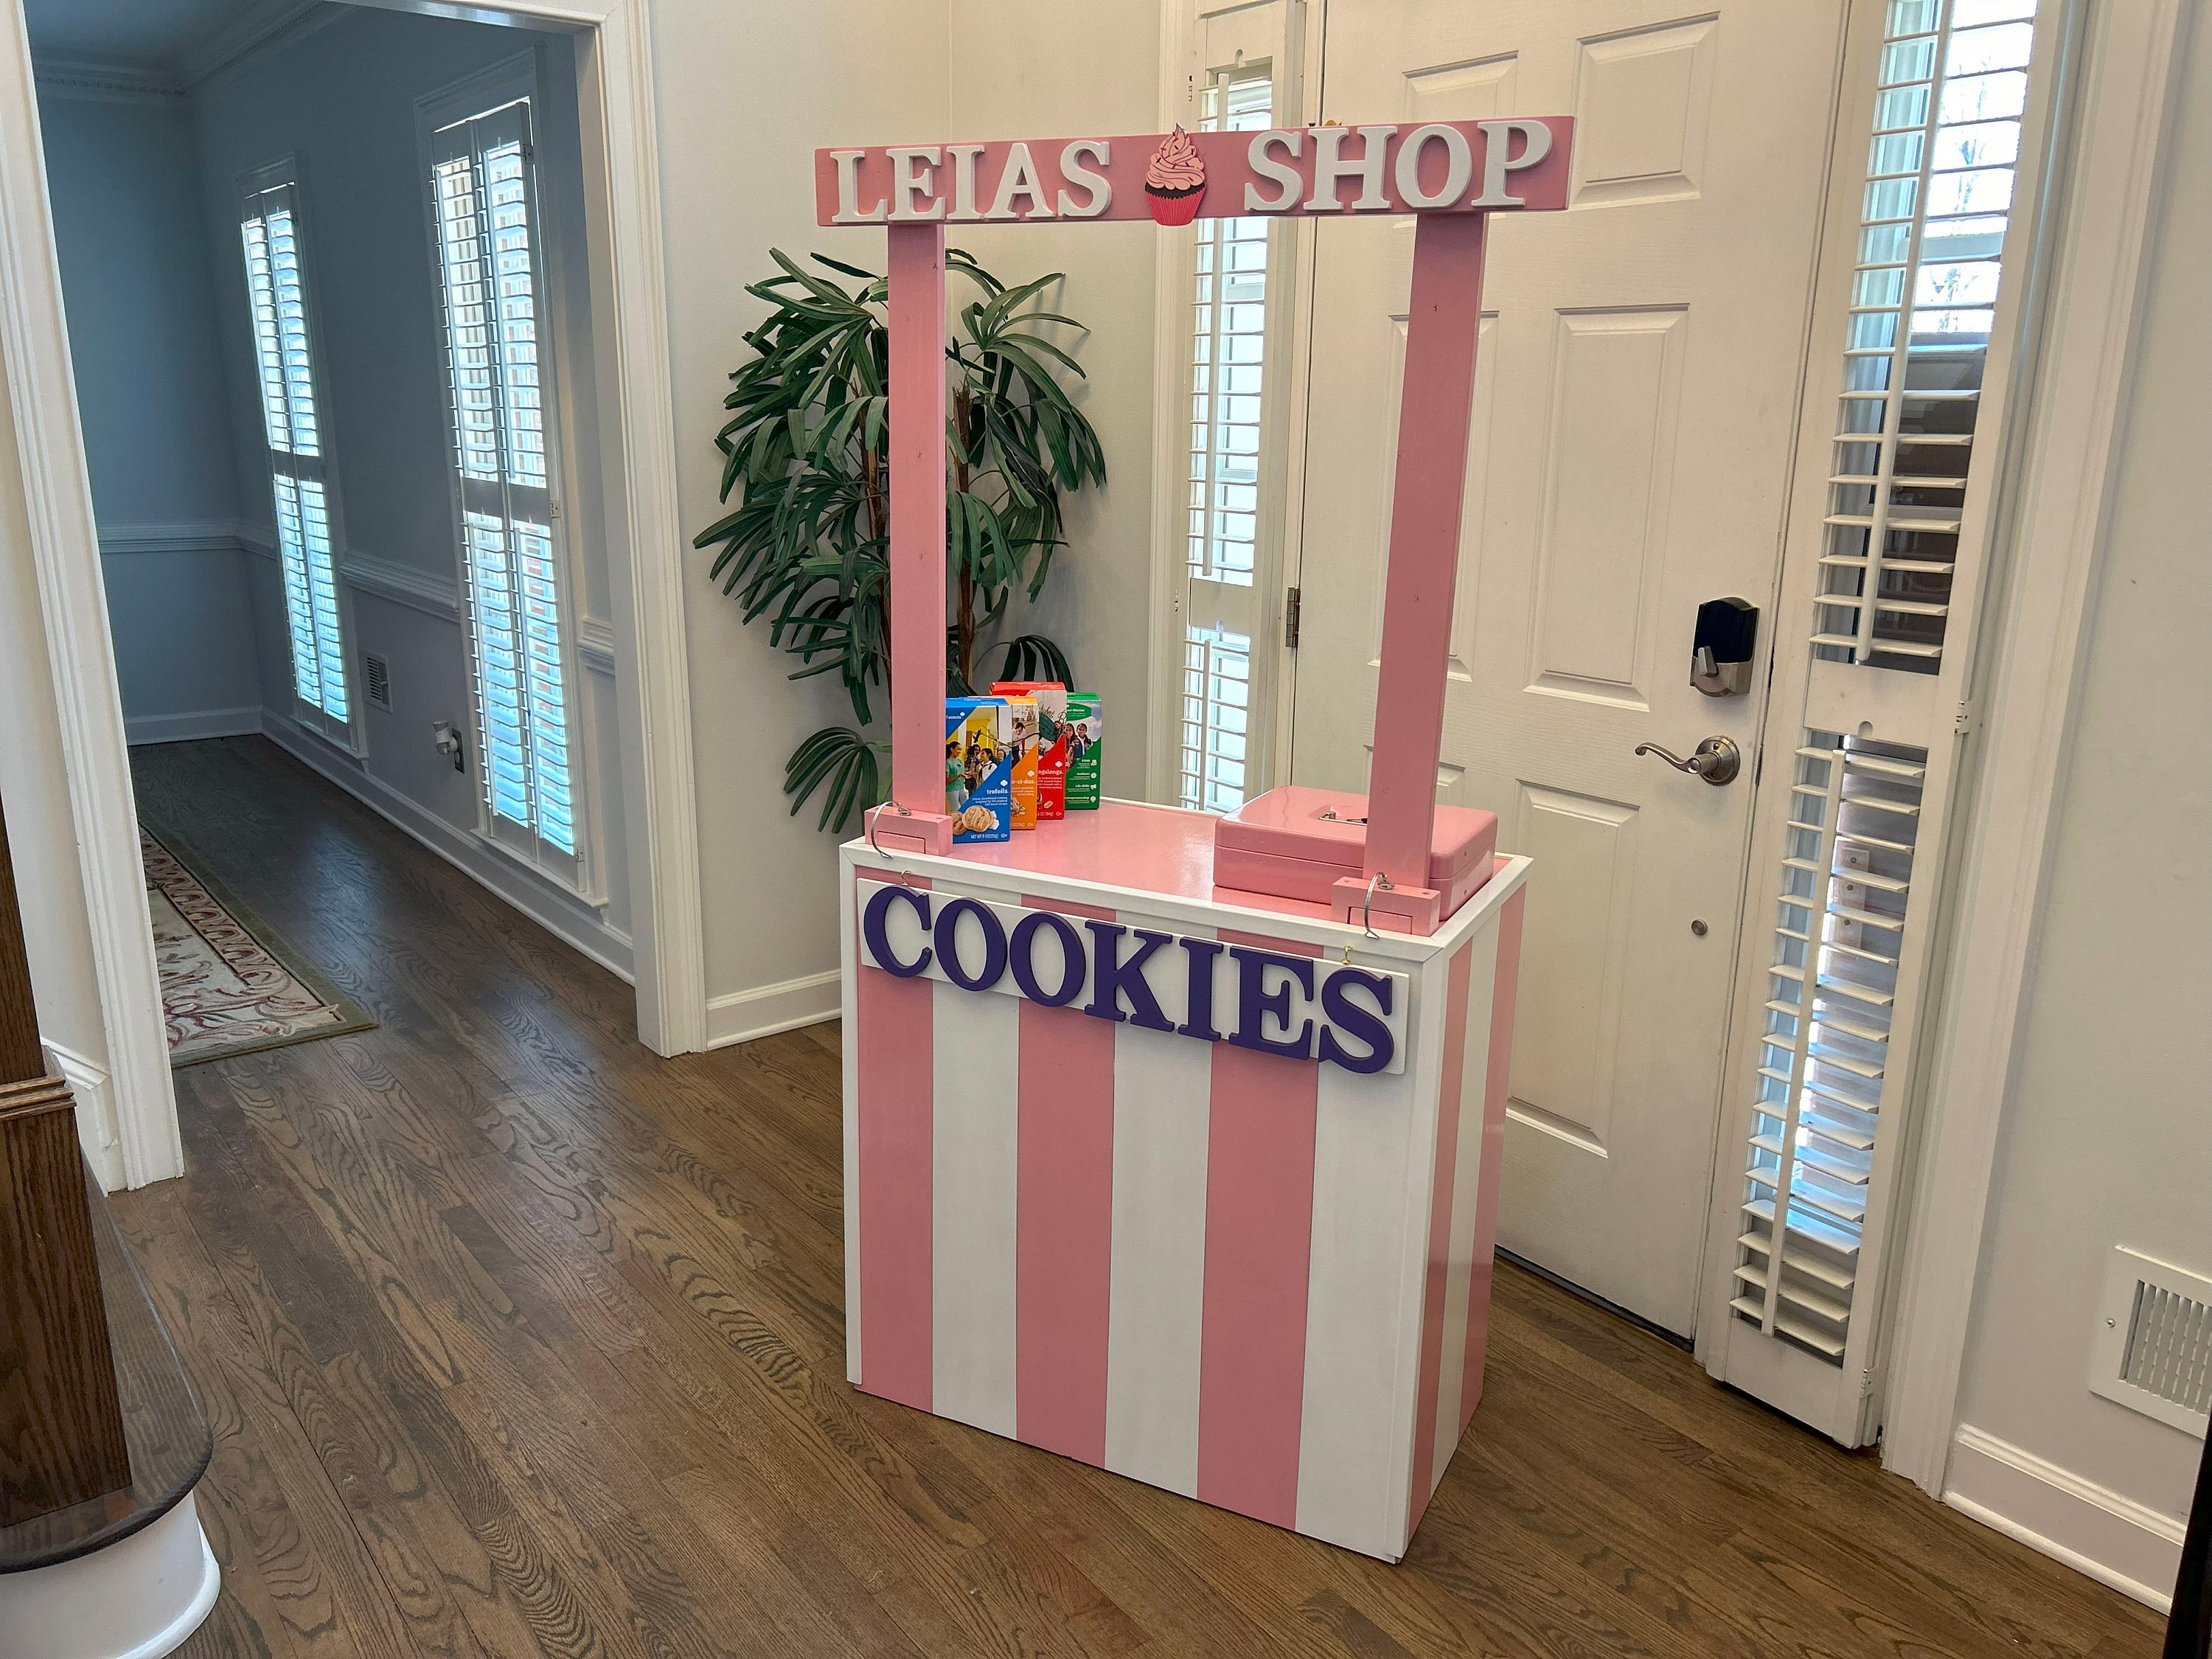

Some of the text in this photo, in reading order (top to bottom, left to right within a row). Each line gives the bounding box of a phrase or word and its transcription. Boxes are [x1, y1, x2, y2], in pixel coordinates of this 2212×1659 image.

[830, 120, 1553, 223] LEIAS SHOP
[863, 886, 1394, 1074] COOKIES
